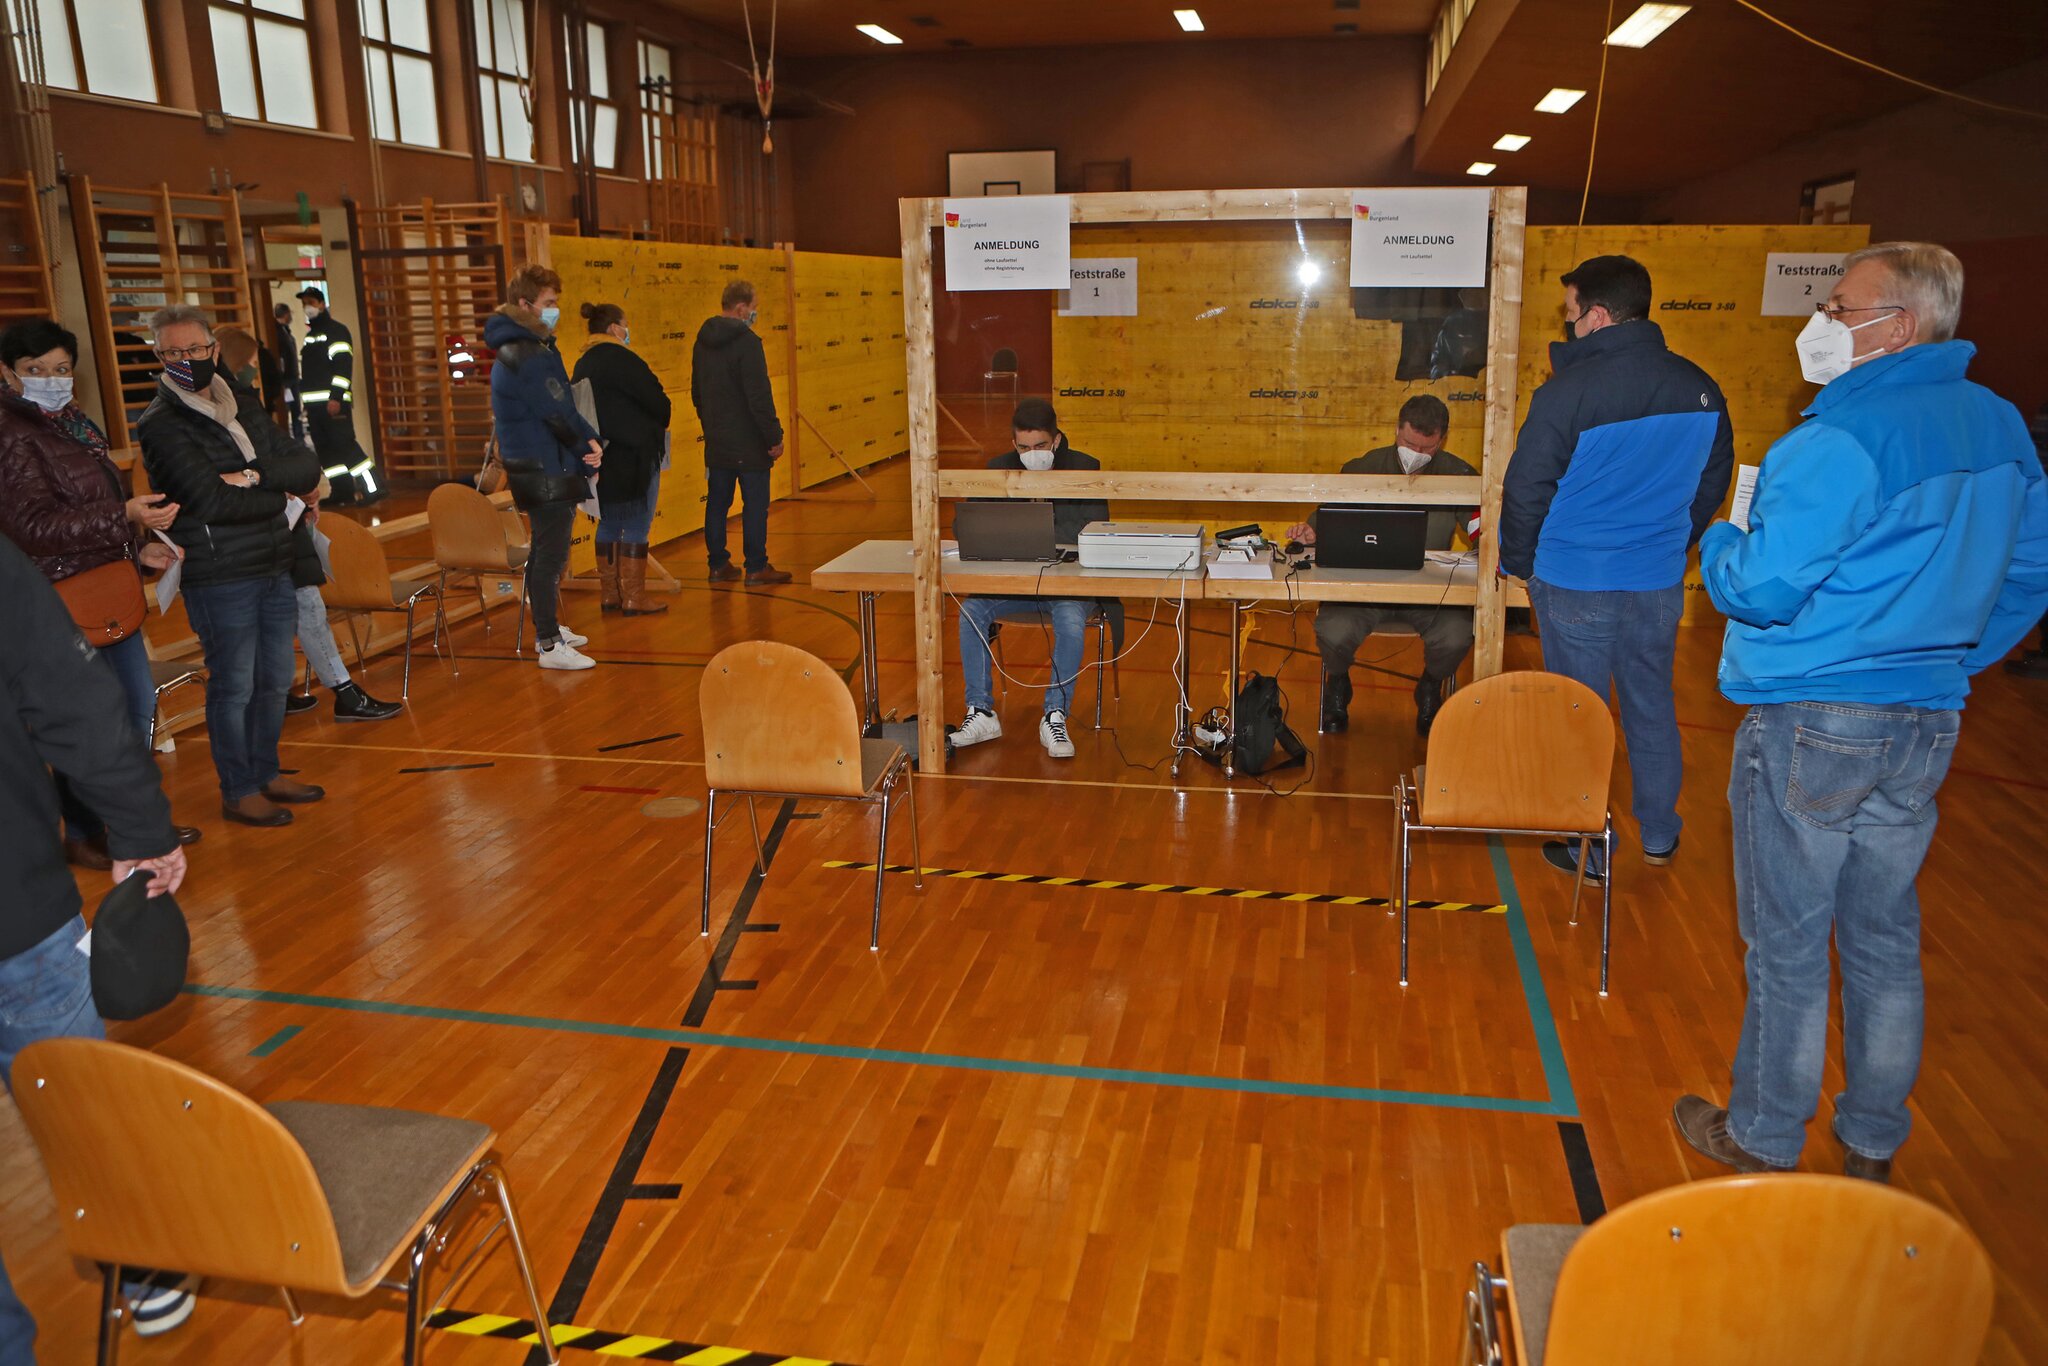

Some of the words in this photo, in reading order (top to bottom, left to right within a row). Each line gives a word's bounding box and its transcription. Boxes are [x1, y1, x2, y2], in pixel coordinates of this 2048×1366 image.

[973, 240, 1040, 250] ANMELDUNG
[1383, 235, 1455, 245] ANMELDUNG
[1070, 268, 1126, 279] Teststraße
[1777, 264, 1845, 277] Teststraße
[1093, 287, 1100, 297] 1
[1804, 284, 1813, 296] 2
[1249, 298, 1297, 309] doka
[1660, 299, 1712, 311] doka
[1060, 387, 1105, 397] doka
[1249, 388, 1297, 398] doka
[1448, 391, 1486, 402] dok
